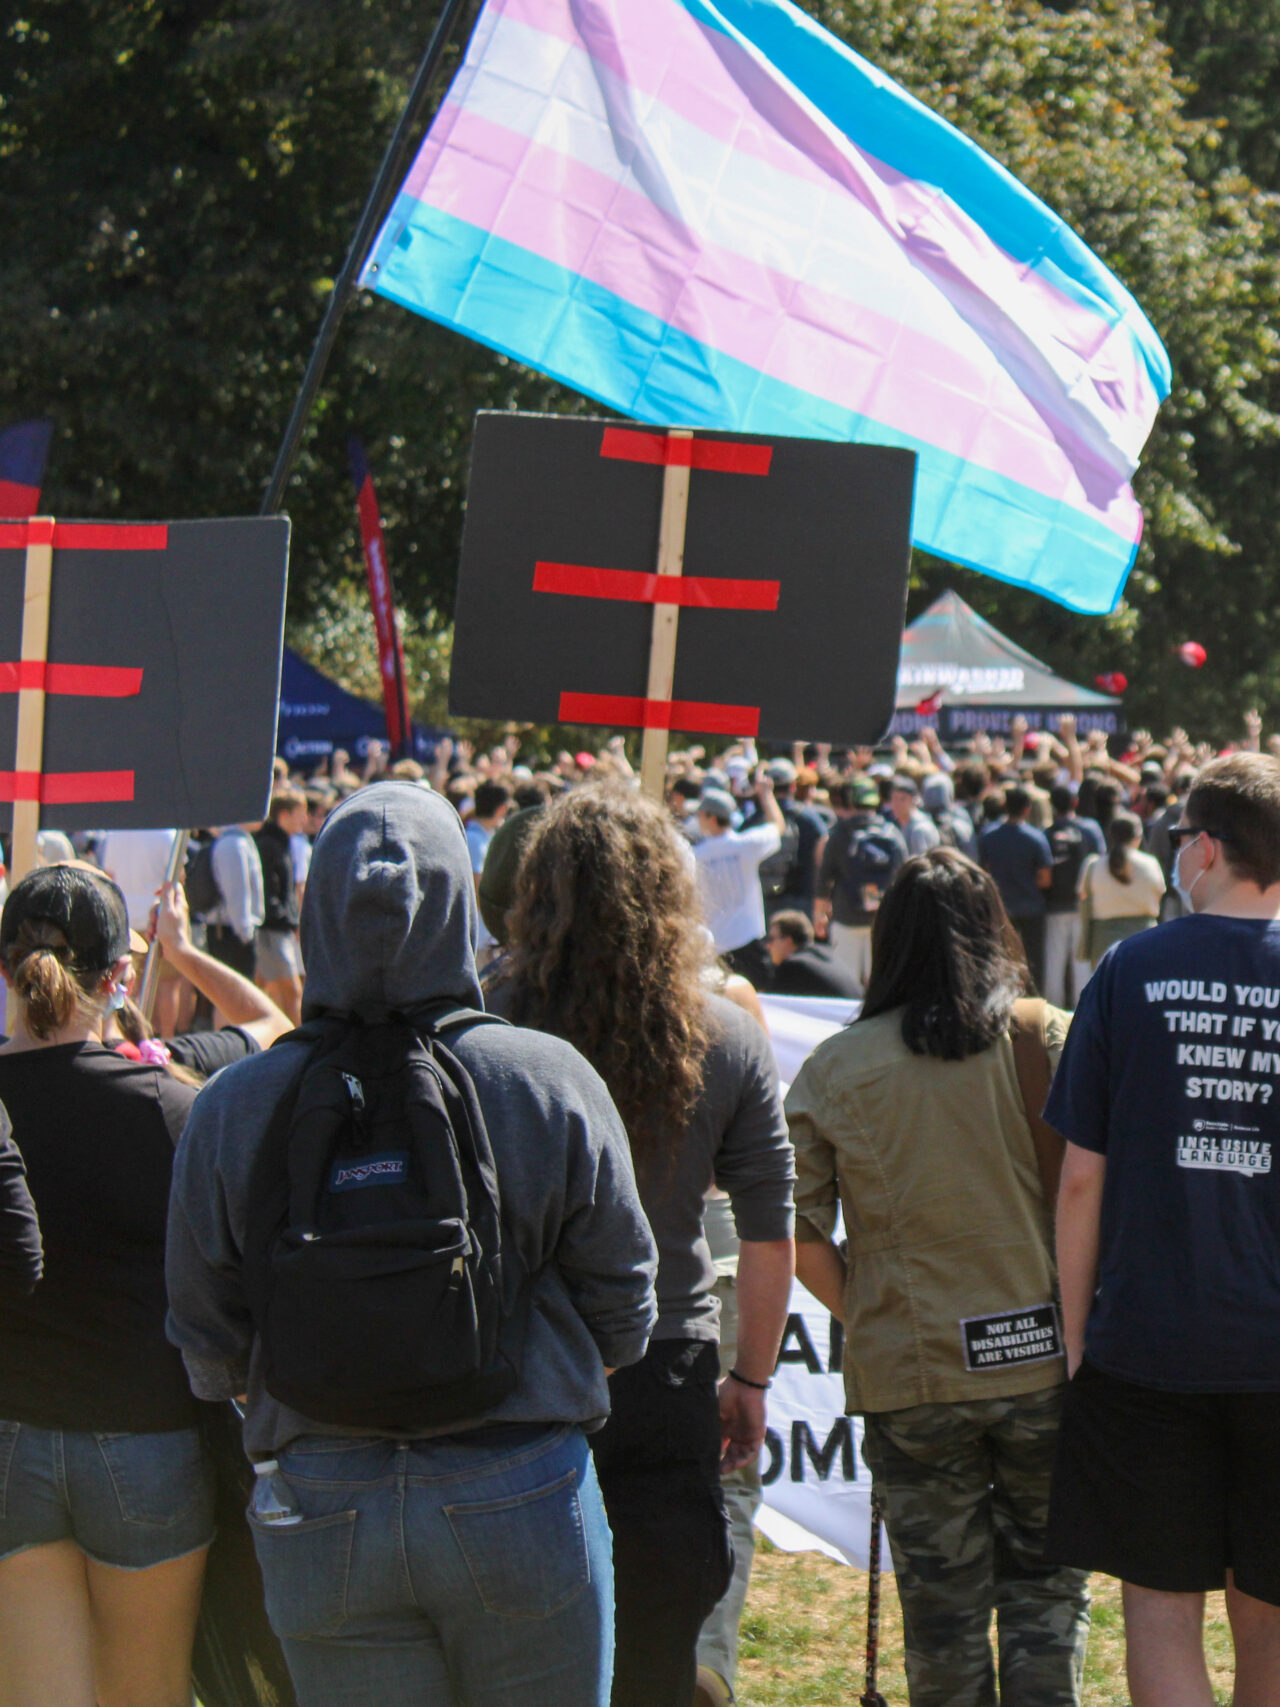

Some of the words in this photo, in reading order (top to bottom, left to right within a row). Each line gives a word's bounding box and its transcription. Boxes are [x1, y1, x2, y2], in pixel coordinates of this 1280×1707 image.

[1046, 712, 1117, 734] WONG
[1145, 979, 1227, 1002] WOULD
[1234, 984, 1280, 1008] YOU
[1164, 1011, 1227, 1035] THAT
[1232, 1016, 1256, 1037] IF
[1177, 1044, 1246, 1069] KNEW
[1186, 1077, 1273, 1104] STORY?
[1178, 1136, 1271, 1154] INCLUSIVE
[1178, 1150, 1271, 1167] LANGUAGE
[986, 1321, 1012, 1336] NOT
[1016, 1317, 1038, 1330] ALL
[971, 1326, 1054, 1352] DISABILITIES
[977, 1350, 1003, 1364] ARE
[1005, 1340, 1054, 1360] VISIBLE
